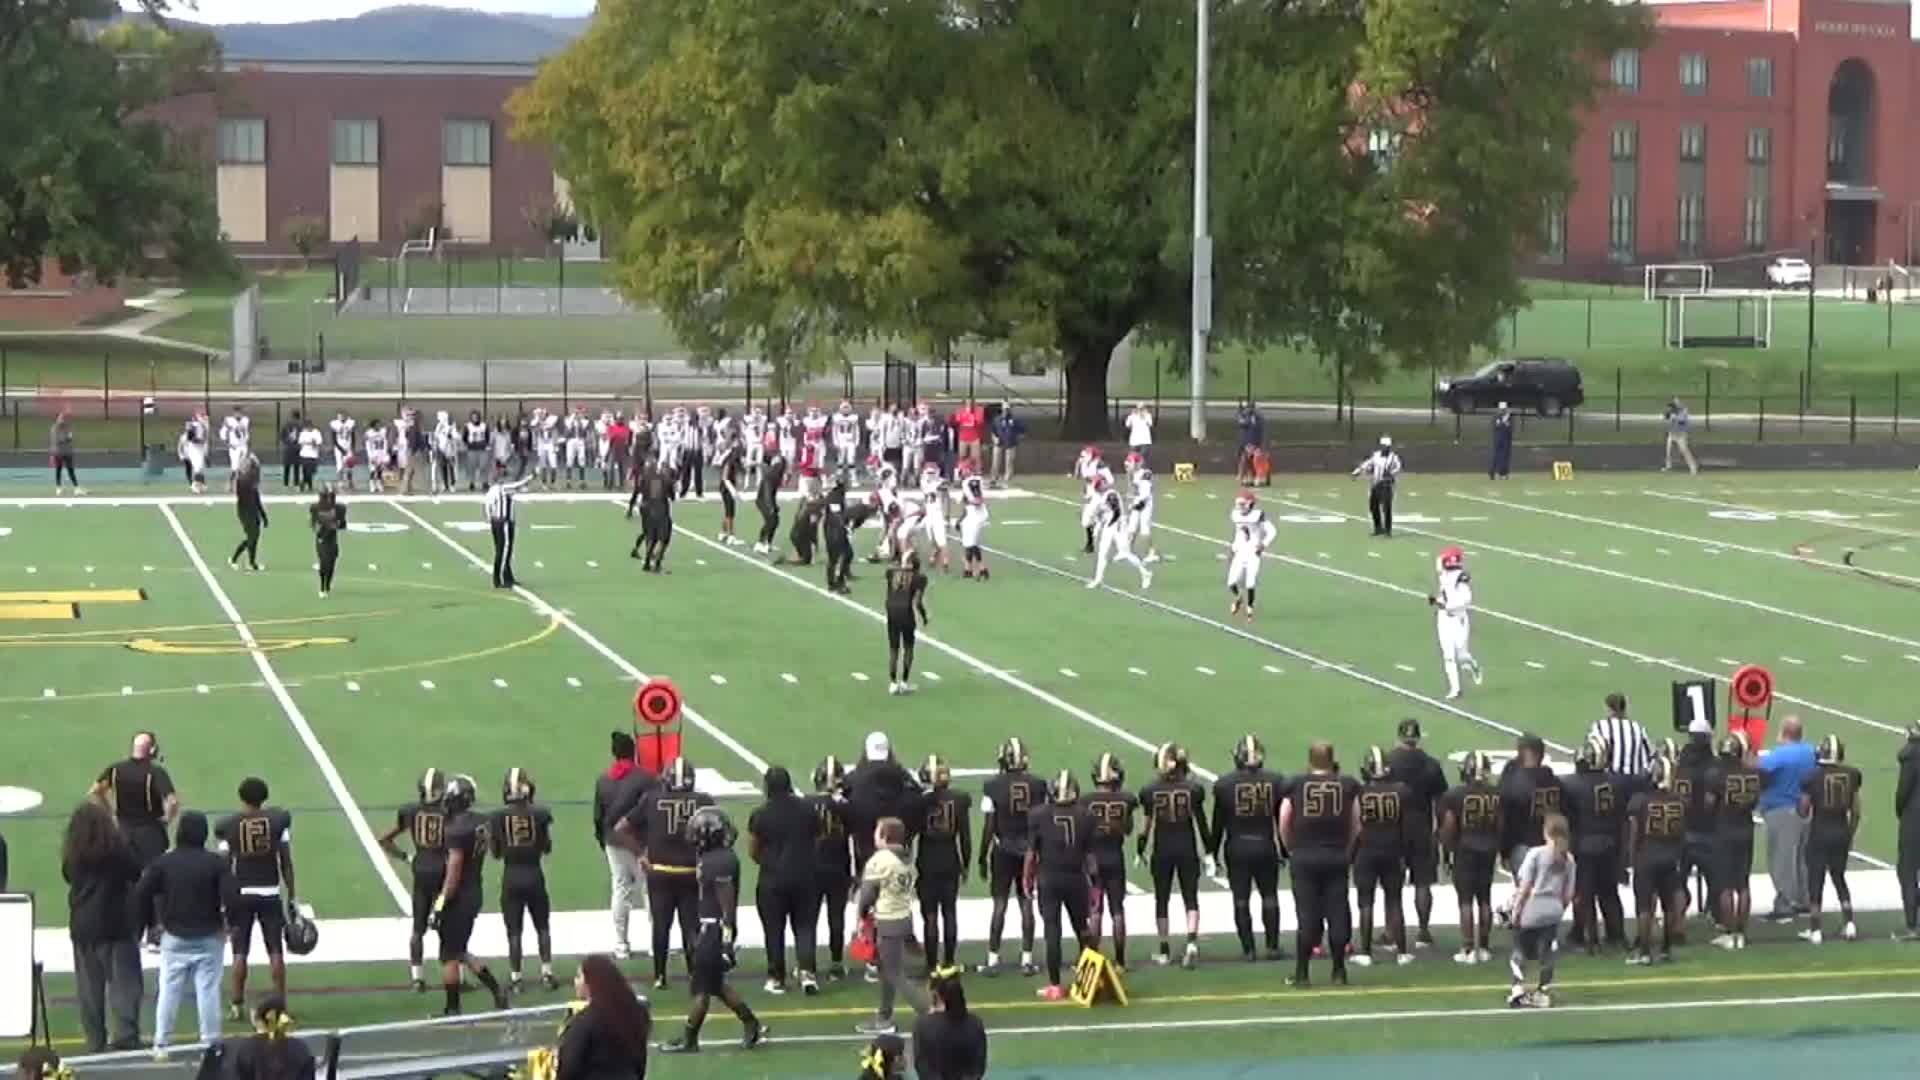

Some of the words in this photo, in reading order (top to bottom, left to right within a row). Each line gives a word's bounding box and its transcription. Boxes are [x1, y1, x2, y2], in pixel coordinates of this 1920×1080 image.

[1687, 685, 1706, 722] 1
[1235, 780, 1272, 816] 54
[1303, 781, 1342, 816] 57
[1054, 815, 1075, 847] 7
